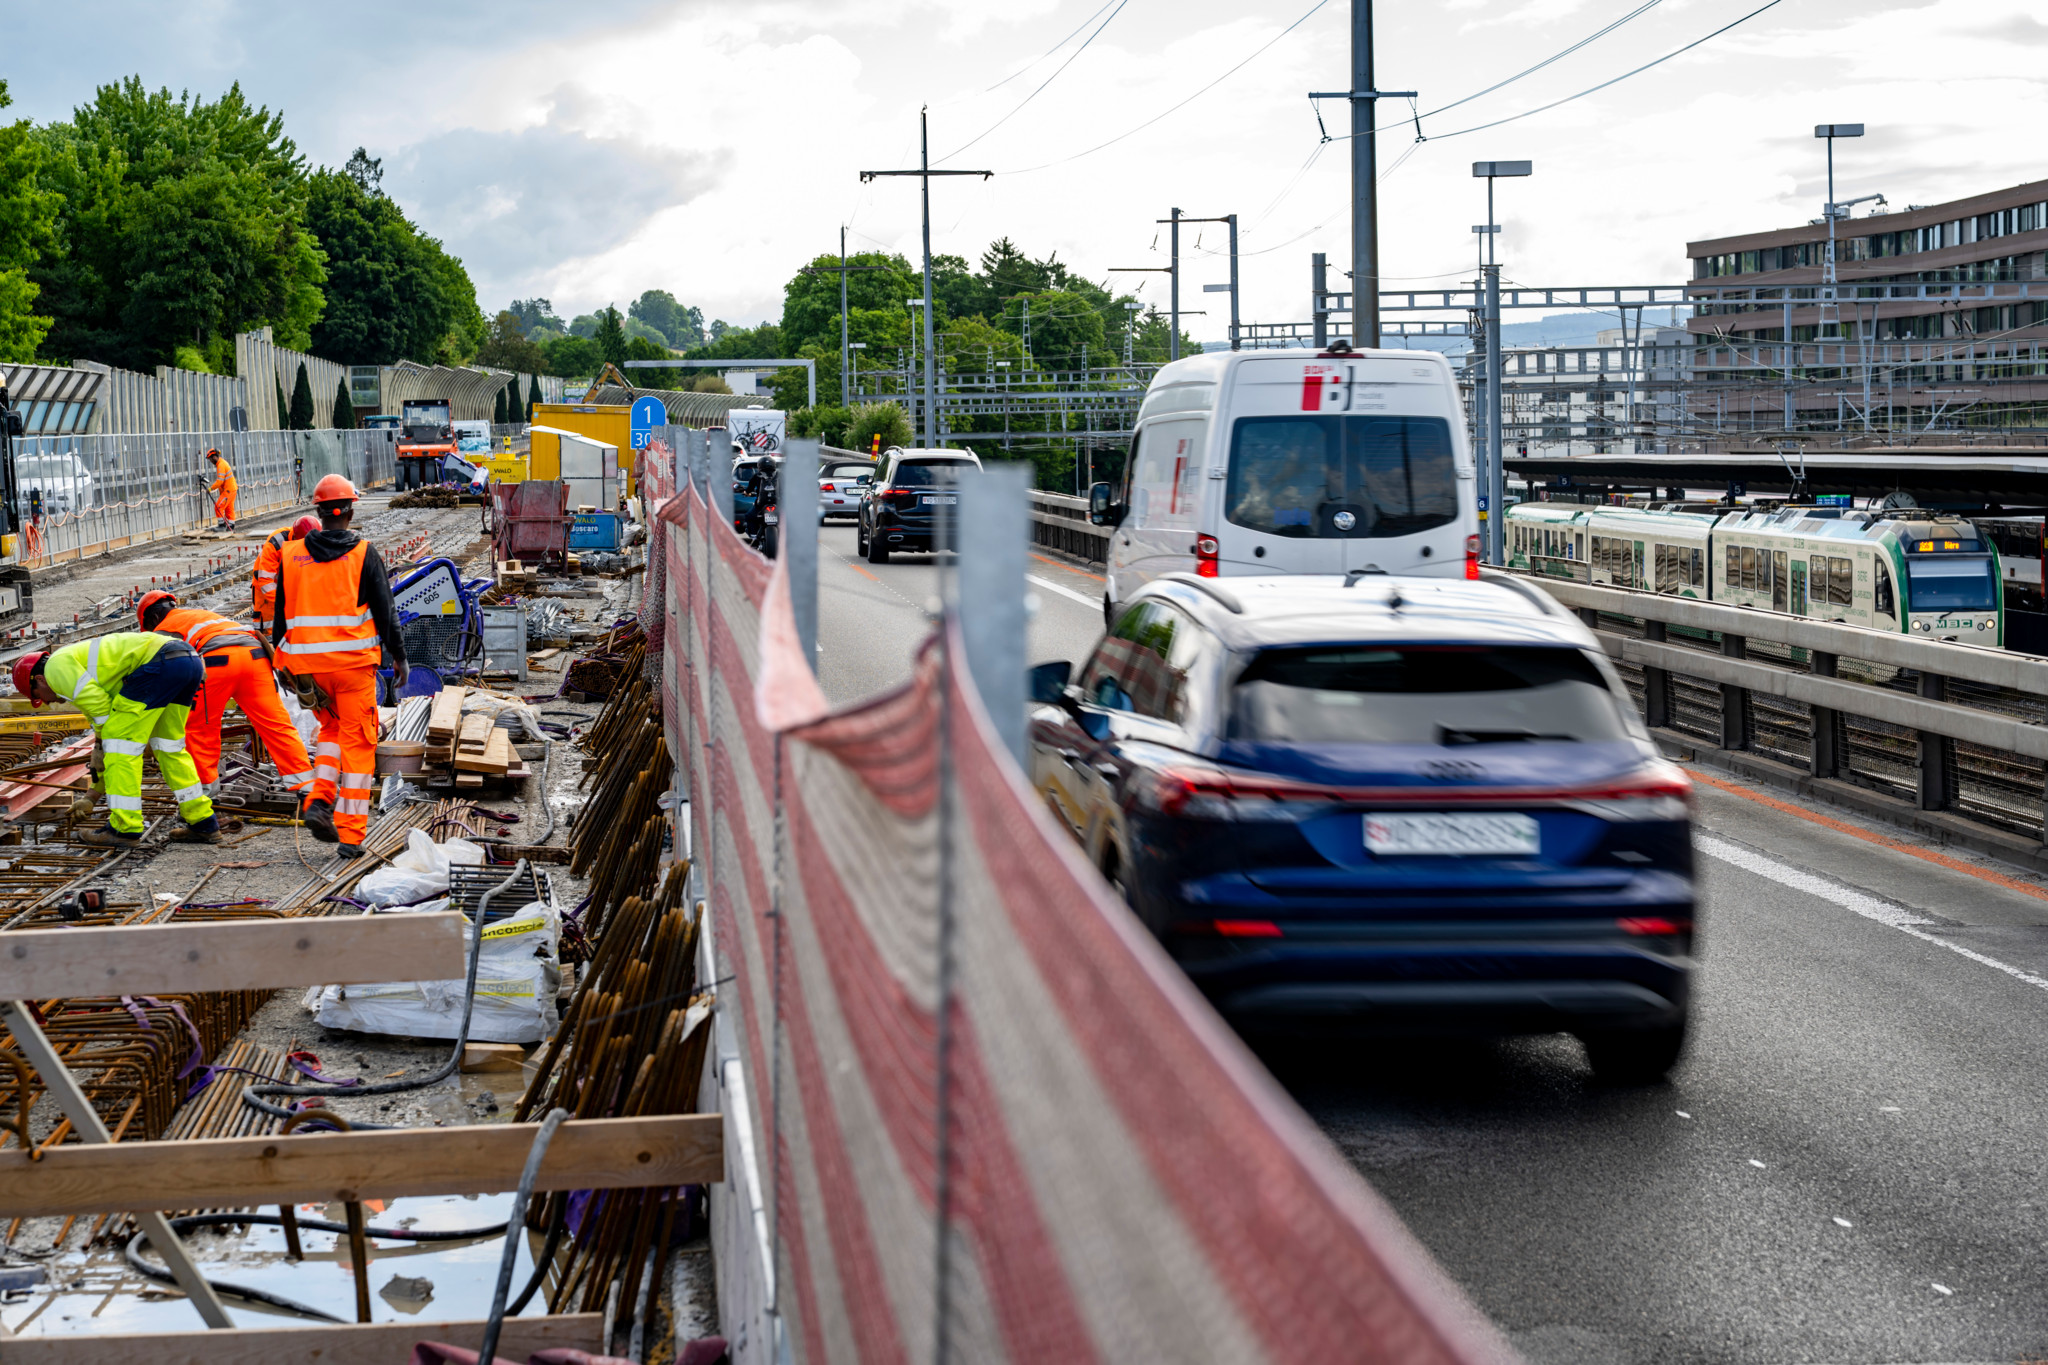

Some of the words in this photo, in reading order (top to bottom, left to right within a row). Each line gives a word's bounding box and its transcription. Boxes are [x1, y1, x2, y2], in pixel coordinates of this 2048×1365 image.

[643, 405, 651, 424] 1
[1561, 477, 1568, 485] 5
[1734, 485, 1741, 494] 5
[1479, 500, 1486, 508] 6
[423, 591, 440, 605] 605
[1936, 619, 1973, 628] MBC
[475, 983, 533, 993] ncotech
